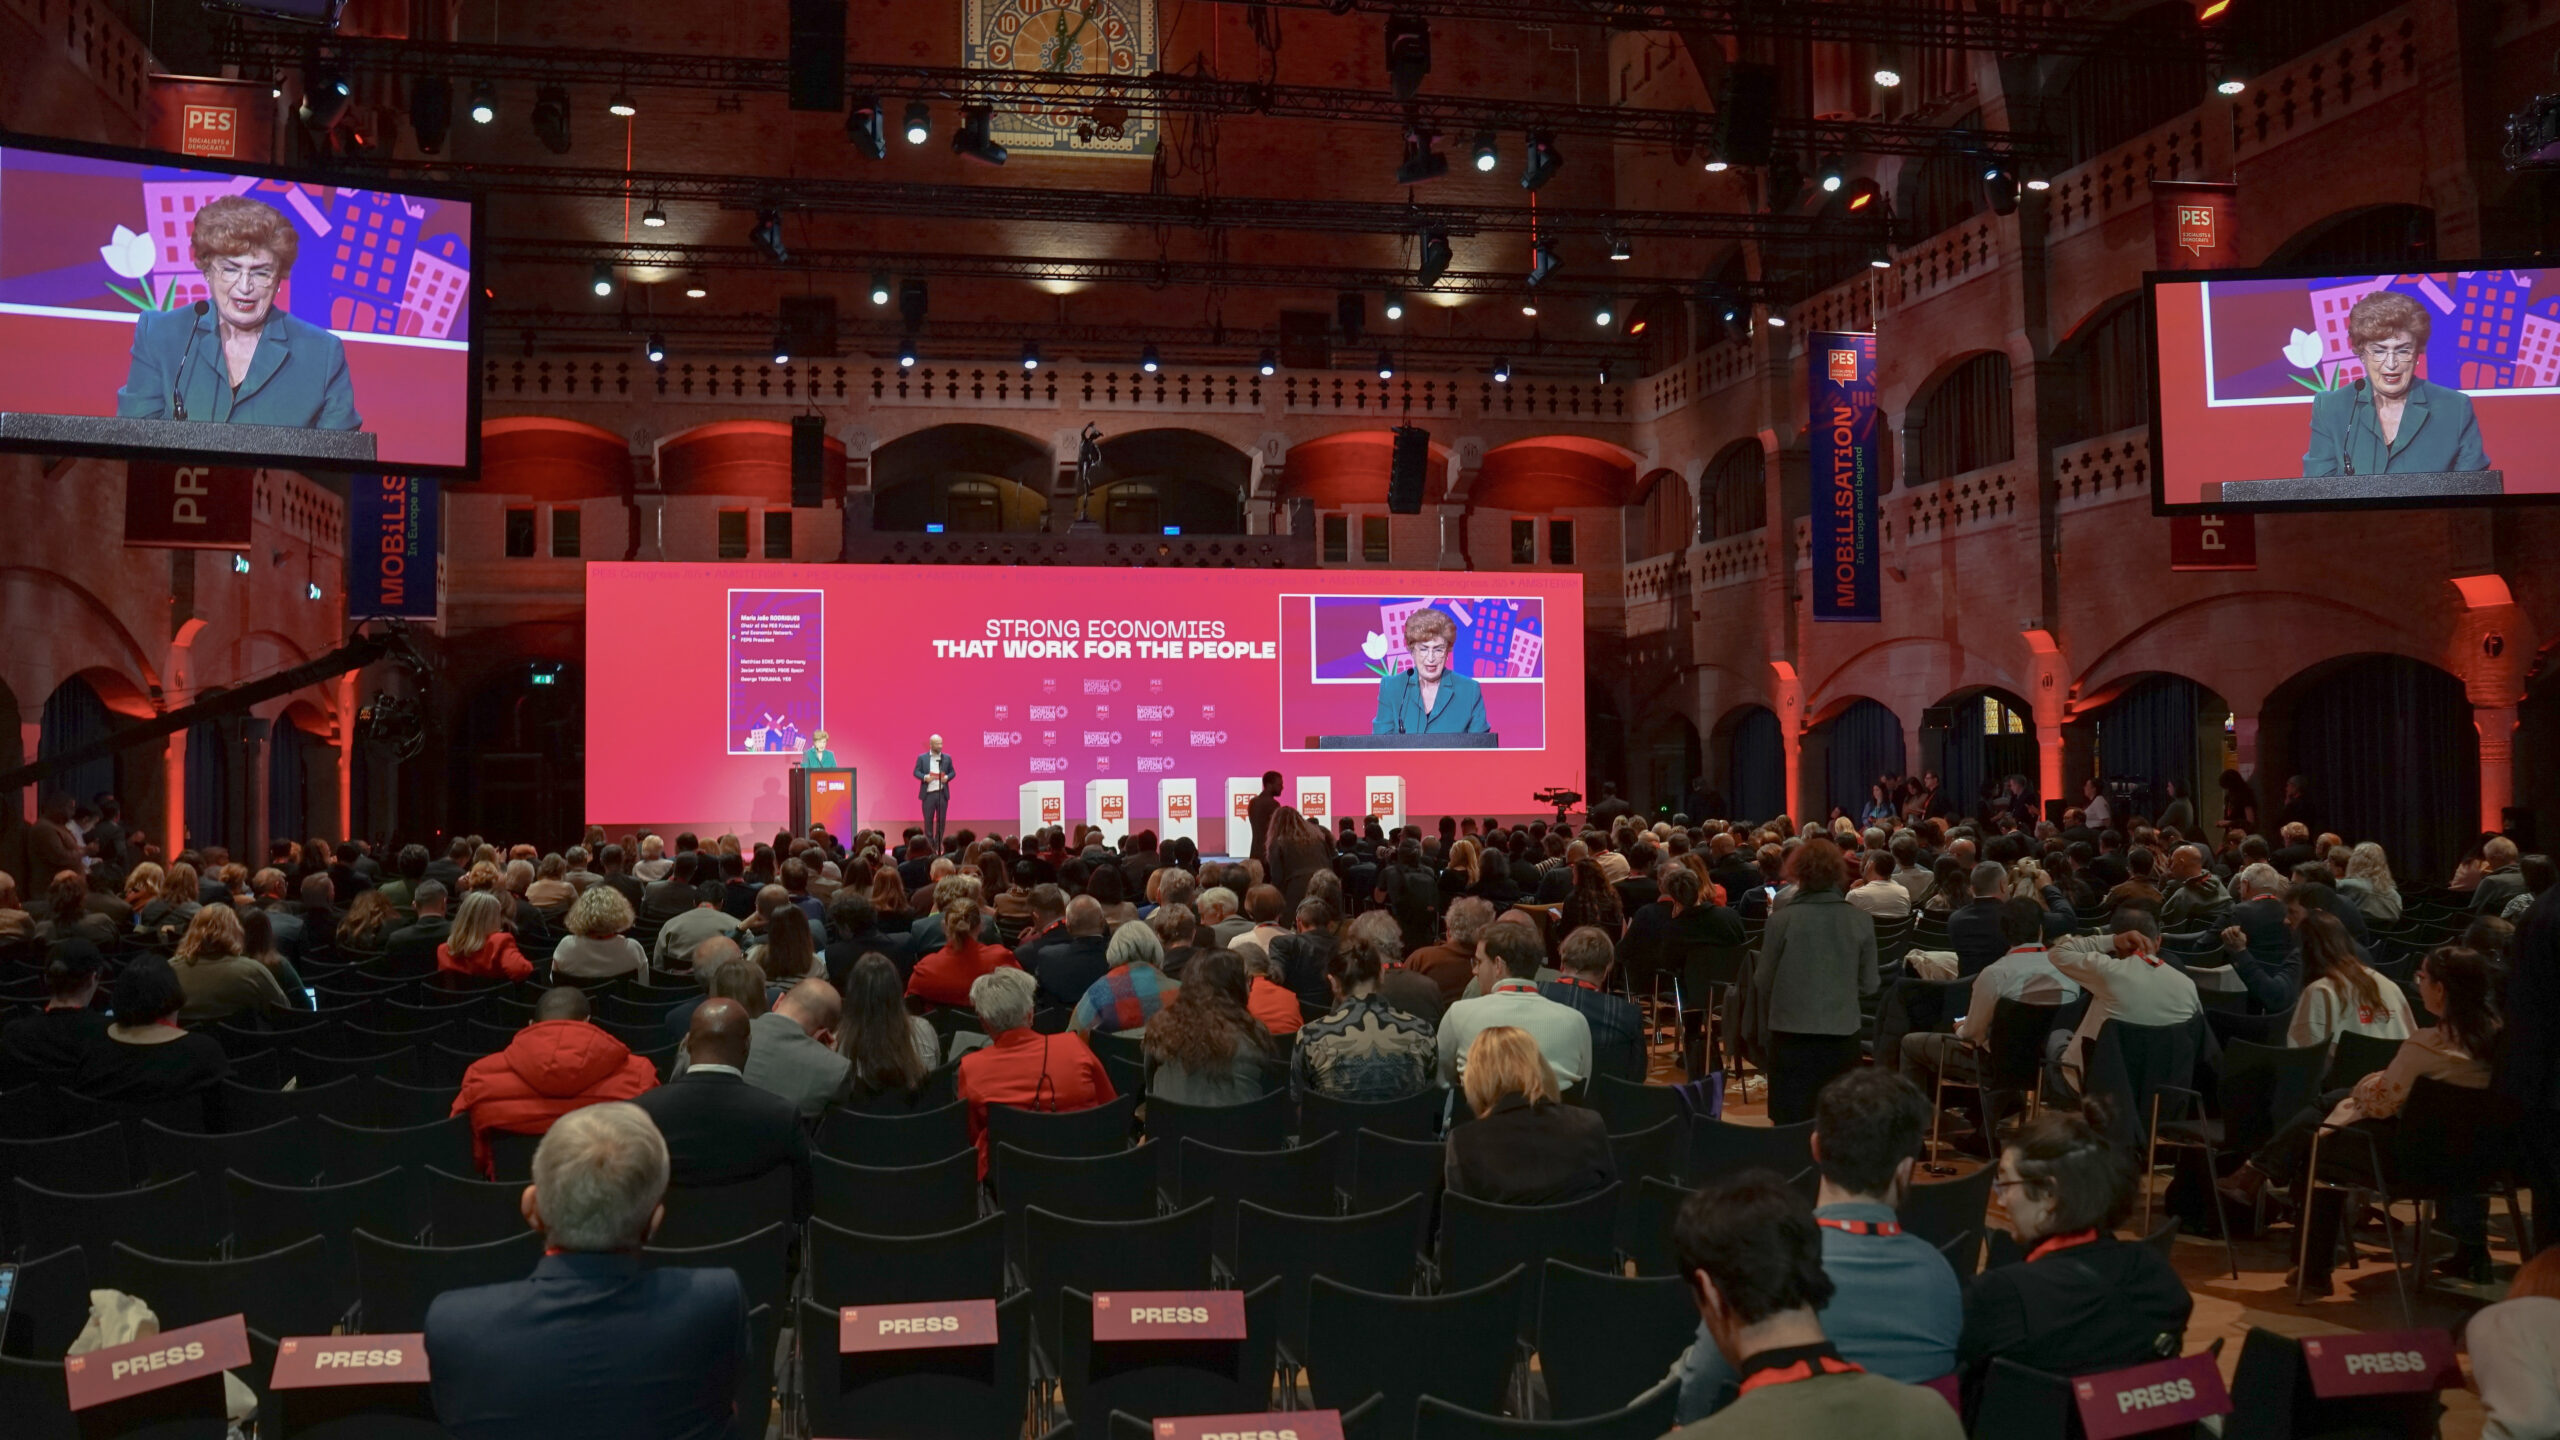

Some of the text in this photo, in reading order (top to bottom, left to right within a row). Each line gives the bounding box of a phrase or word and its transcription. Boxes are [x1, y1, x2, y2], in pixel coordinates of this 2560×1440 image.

[1001, 15, 1016, 31] 10
[1109, 23, 1120, 39] 2
[994, 45, 1007, 62] 9
[1117, 51, 1129, 69] 3
[189, 110, 231, 131] PES
[188, 137, 225, 145] SOCIALISTS
[188, 144, 226, 152] DEMOCRATS
[2181, 210, 2210, 226] PES
[1831, 352, 1854, 365] PES
[1854, 446, 1864, 486] beyond
[408, 496, 420, 539] Europe
[1856, 512, 1864, 549] Europe
[1857, 552, 1864, 565] In
[986, 619, 1225, 639] STRONG ECONOMIES
[933, 640, 1276, 659] THAT WORK FOR THE PEOPLE
[1043, 799, 1059, 810] PES
[1102, 797, 1122, 807] PES
[1169, 796, 1190, 807] PES
[1304, 794, 1324, 804] PES
[1372, 793, 1392, 804] PES
[1130, 1307, 1209, 1324] PRESS
[879, 1316, 959, 1335] PRESS
[111, 1341, 205, 1380] PRESS
[315, 1349, 402, 1369] PRESS
[2344, 1350, 2426, 1375] PRESS
[2116, 1377, 2196, 1414] PRESS
